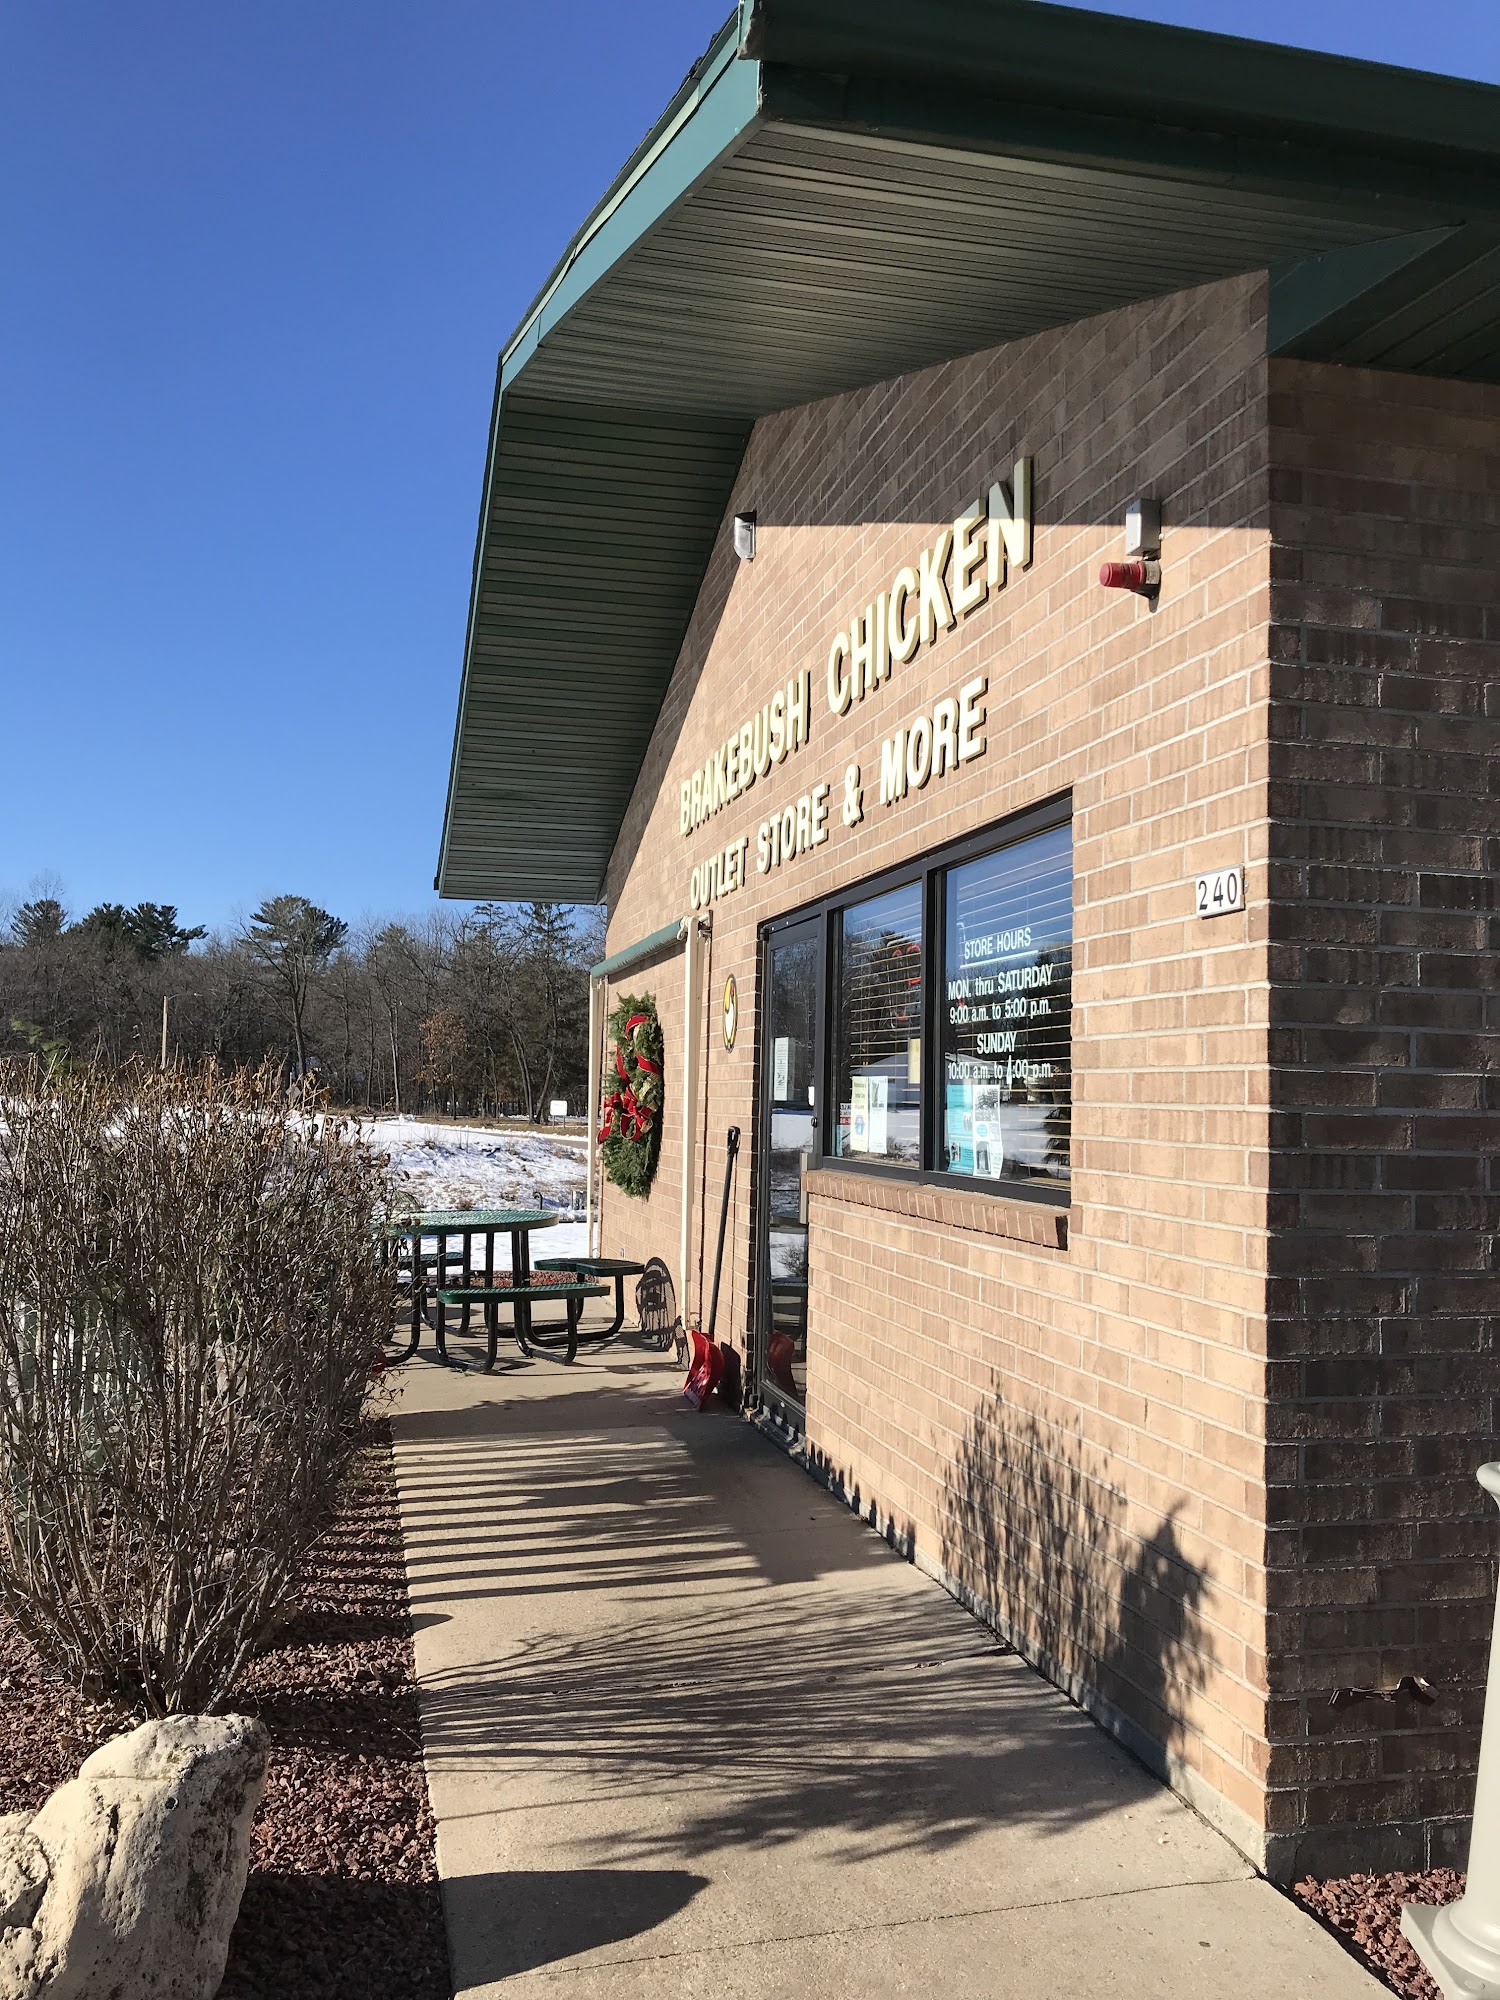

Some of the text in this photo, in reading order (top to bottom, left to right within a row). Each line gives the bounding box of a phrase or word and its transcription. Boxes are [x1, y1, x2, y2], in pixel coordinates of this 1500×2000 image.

[680, 457, 1031, 836] BRAKEBUSH CHICKEN
[690, 676, 986, 910] OUTLET STORE & MORE
[1198, 872, 1238, 911] 240
[964, 926, 1031, 960] STORE HOURS
[948, 962, 1054, 1001] MON. thru SATURDAY
[949, 997, 1052, 1025] 9:00 a.m. to 5:00 p.m.
[976, 1030, 1017, 1055] SUNDAY
[947, 1061, 970, 1080] 10:00
[972, 1064, 991, 1080] a.m.
[994, 1061, 1003, 1080] to
